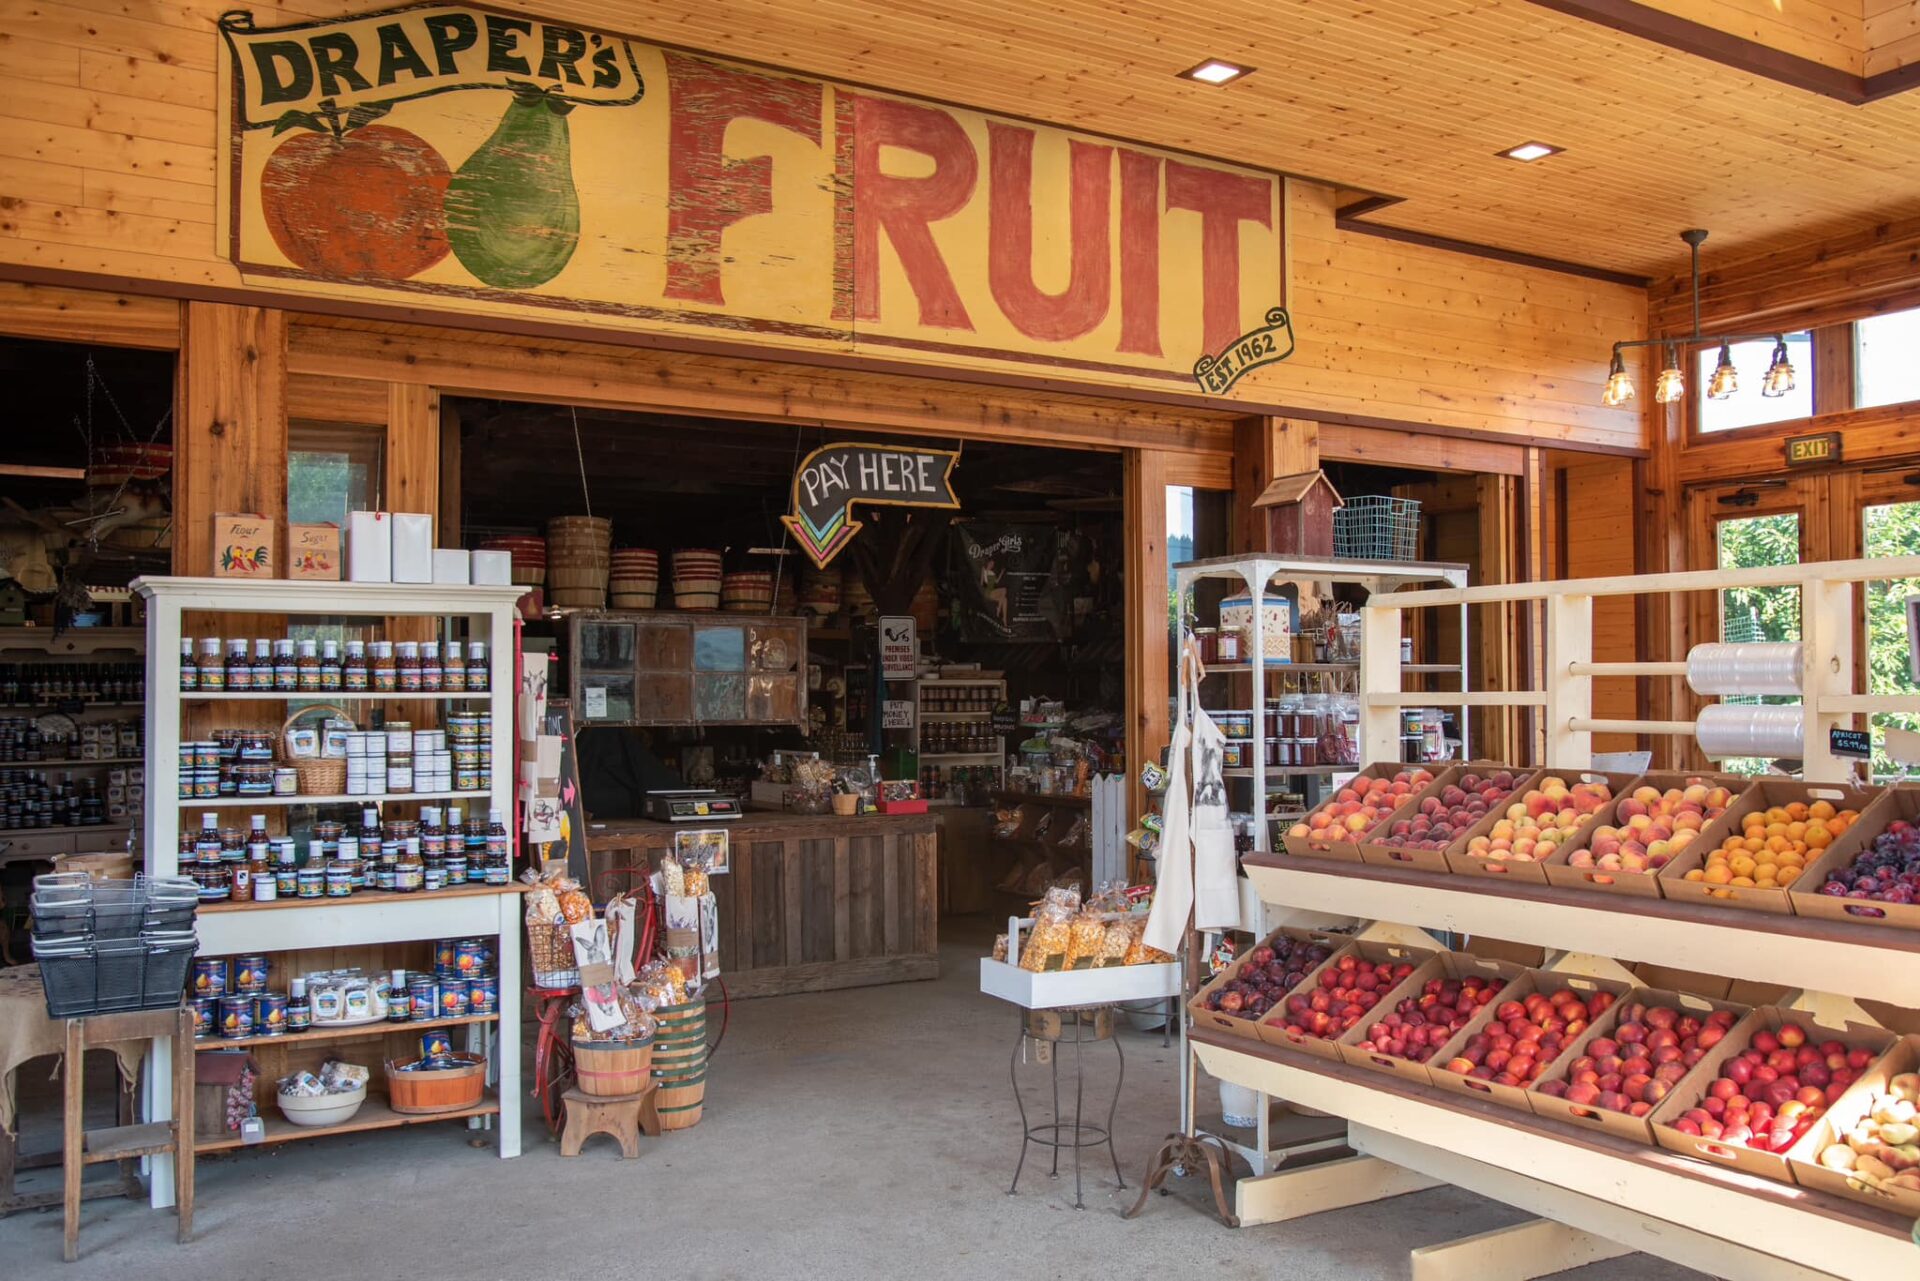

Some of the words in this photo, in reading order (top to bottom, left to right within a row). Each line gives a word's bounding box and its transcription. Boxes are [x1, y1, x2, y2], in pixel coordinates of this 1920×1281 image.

[663, 50, 1273, 360] FRUIT
[1204, 356, 1239, 392] EST.
[1235, 334, 1277, 367] 1962
[1793, 440, 1829, 459] EXIT
[801, 454, 849, 507] PAY
[858, 453, 936, 493] HERE
[301, 531, 328, 545] Sugar
[999, 535, 1022, 553] Girls
[883, 710, 909, 718] MONEY
[890, 701, 904, 709] PUT
